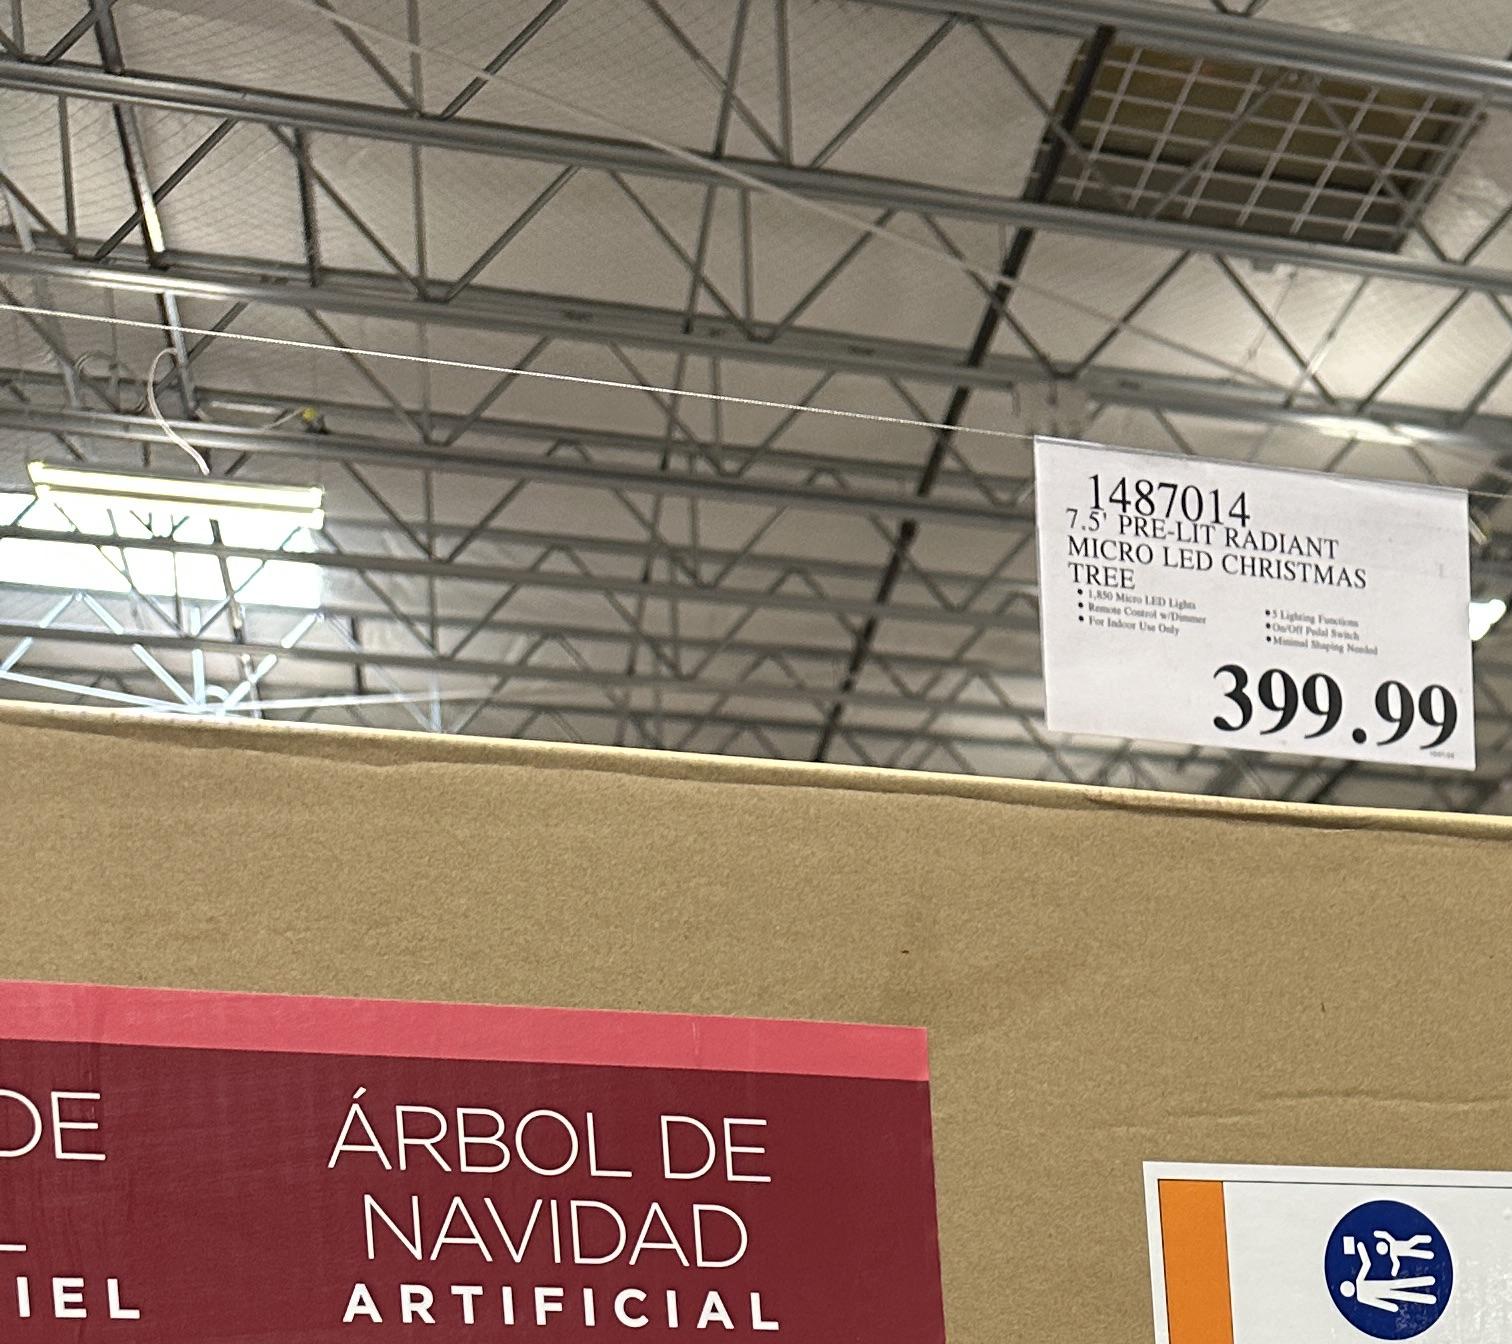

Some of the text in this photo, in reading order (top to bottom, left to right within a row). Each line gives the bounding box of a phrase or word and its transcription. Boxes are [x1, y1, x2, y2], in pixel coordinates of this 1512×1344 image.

[1089, 474, 1251, 527] 1487014
[1066, 508, 1339, 559] 7.5' PRE-LIT RADIANT
[1067, 534, 1367, 589] MICRO LED CHRISTMAS
[1068, 562, 1136, 590] TREE
[1089, 615, 1180, 636] For Indoor Use Only
[1116, 592, 1142, 603] Micro
[1145, 595, 1166, 607] LED
[1169, 597, 1196, 610] Lights
[1213, 664, 1458, 750] 399.99
[328, 1087, 771, 1182] ÁRBOL DE
[364, 1195, 747, 1267] NAVIDAD
[343, 1284, 779, 1330] ARTIFICIAL
